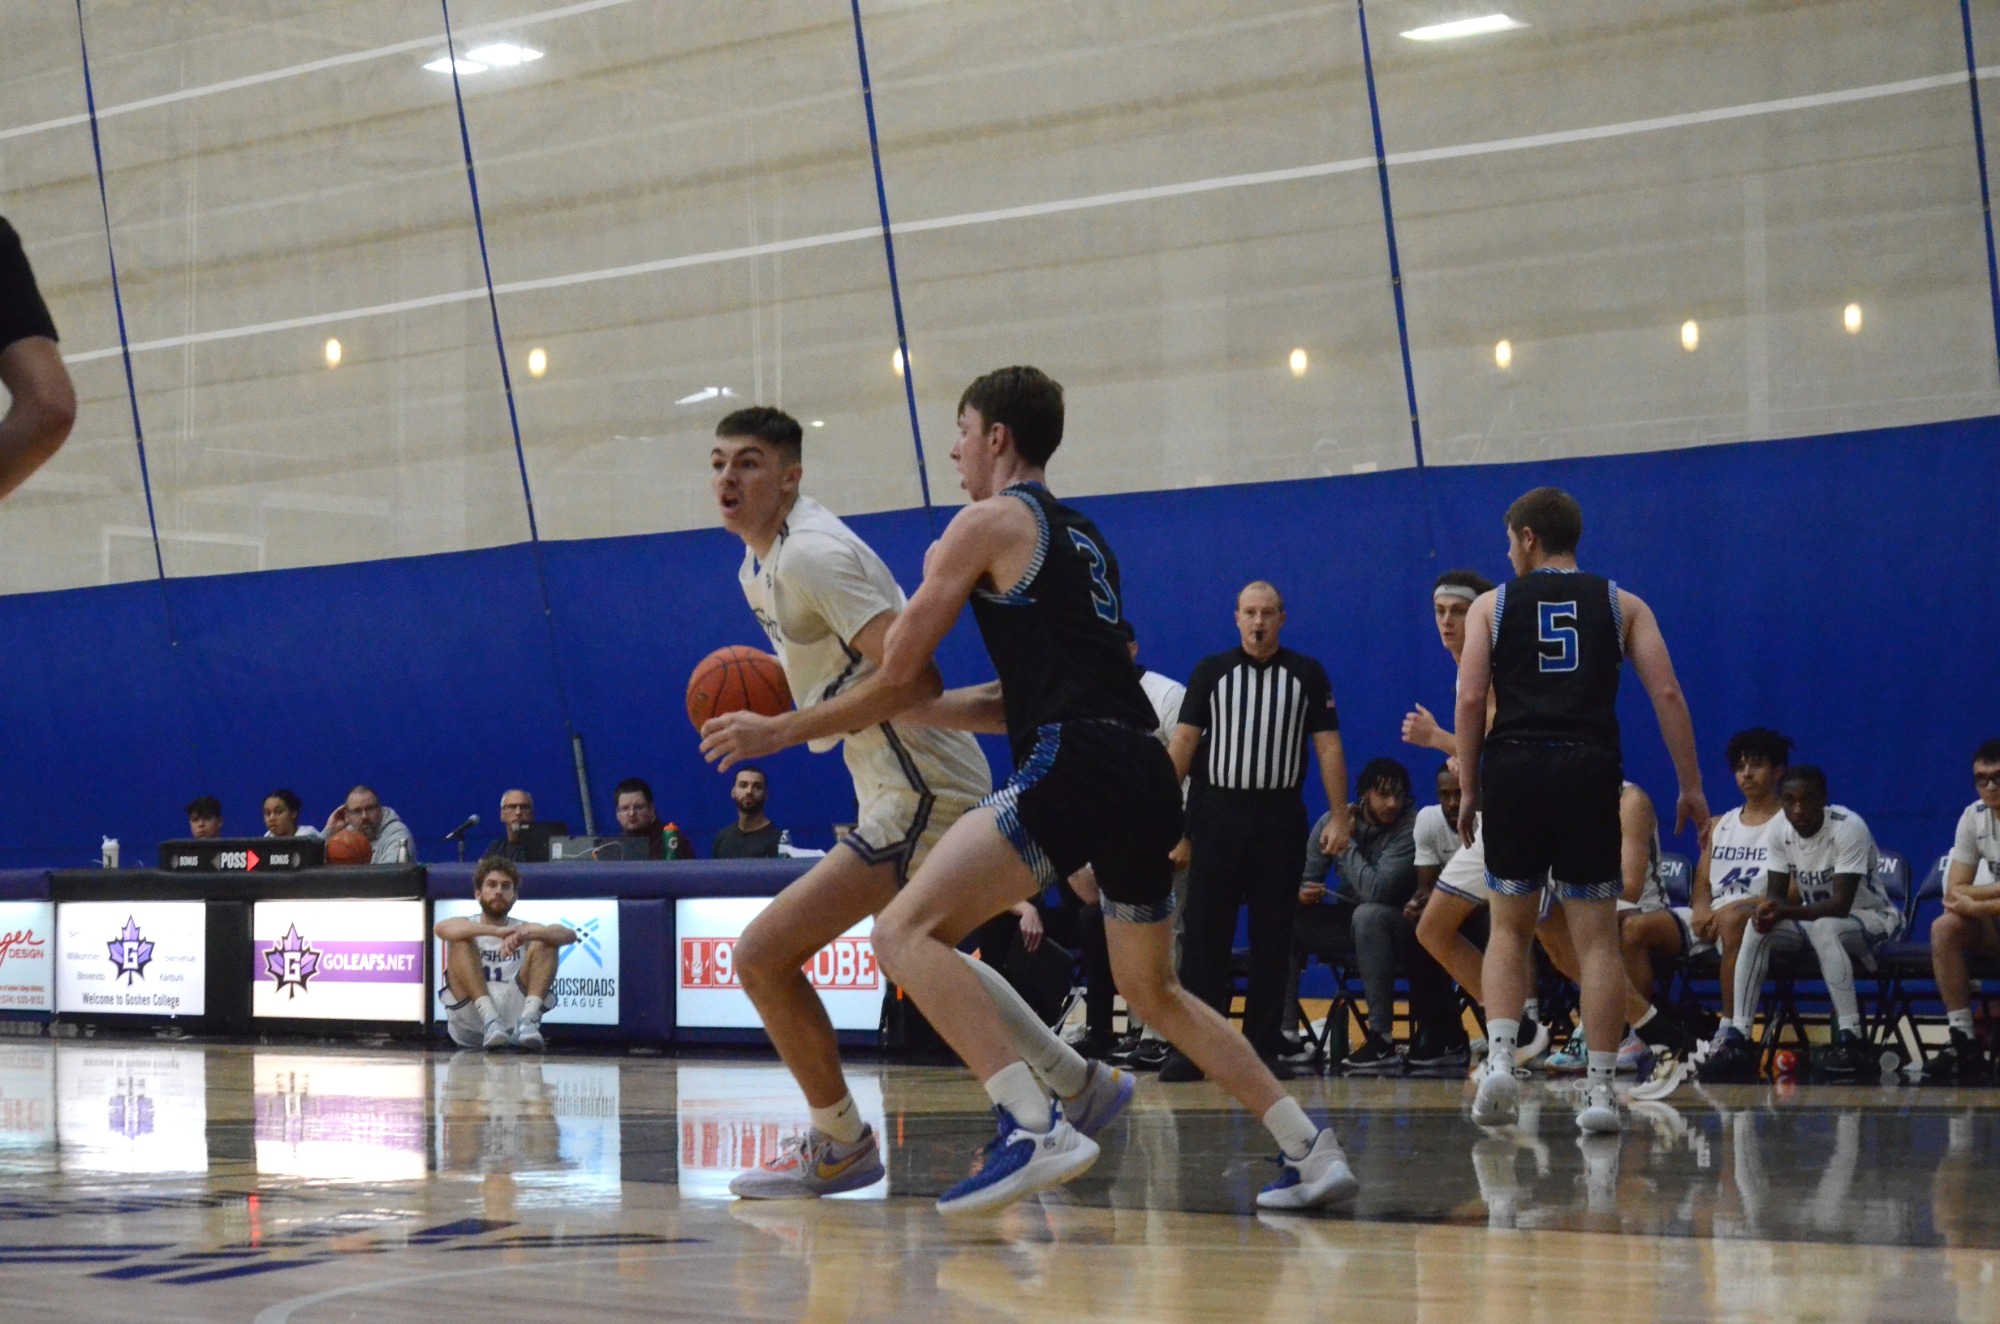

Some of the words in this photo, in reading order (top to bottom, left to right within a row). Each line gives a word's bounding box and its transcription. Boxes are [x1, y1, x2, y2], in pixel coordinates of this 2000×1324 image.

[1067, 526, 1118, 624] 3
[1538, 600, 1578, 672] 5
[179, 856, 199, 867] BONUS
[221, 852, 247, 869] POSS
[270, 854, 290, 866] BONUS
[1712, 846, 1768, 861] GOSHE
[9, 948, 44, 959] DESIGN
[322, 952, 415, 972] GOLEAFS.NET
[804, 942, 876, 985] OBE
[552, 977, 616, 997] ROSSROADS
[82, 992, 114, 1005] Welcome
[116, 993, 123, 1006] to
[125, 993, 151, 1006] Goshen
[153, 993, 180, 1009] College
